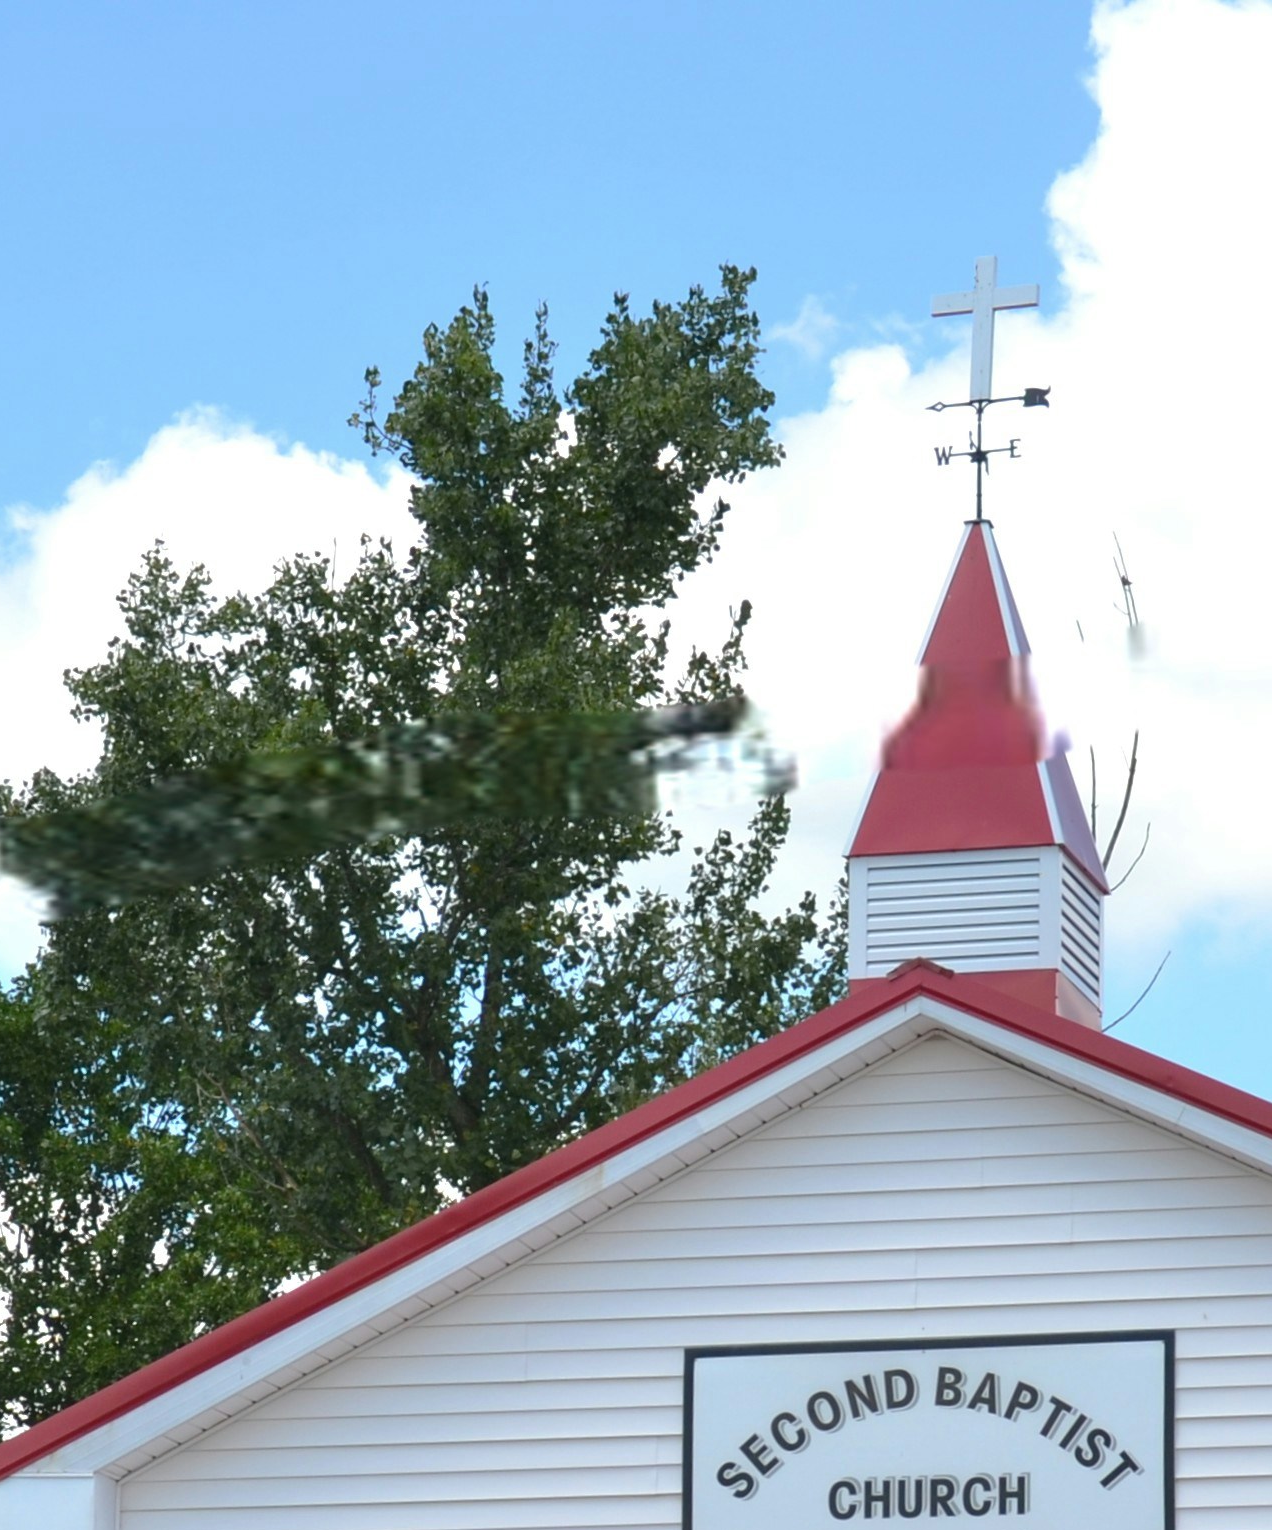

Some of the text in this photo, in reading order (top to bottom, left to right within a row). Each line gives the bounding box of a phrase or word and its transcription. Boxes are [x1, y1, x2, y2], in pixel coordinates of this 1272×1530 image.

[715, 1366, 1144, 1501] SECOND BAPTIST
[828, 1471, 1031, 1521] CHURCH
